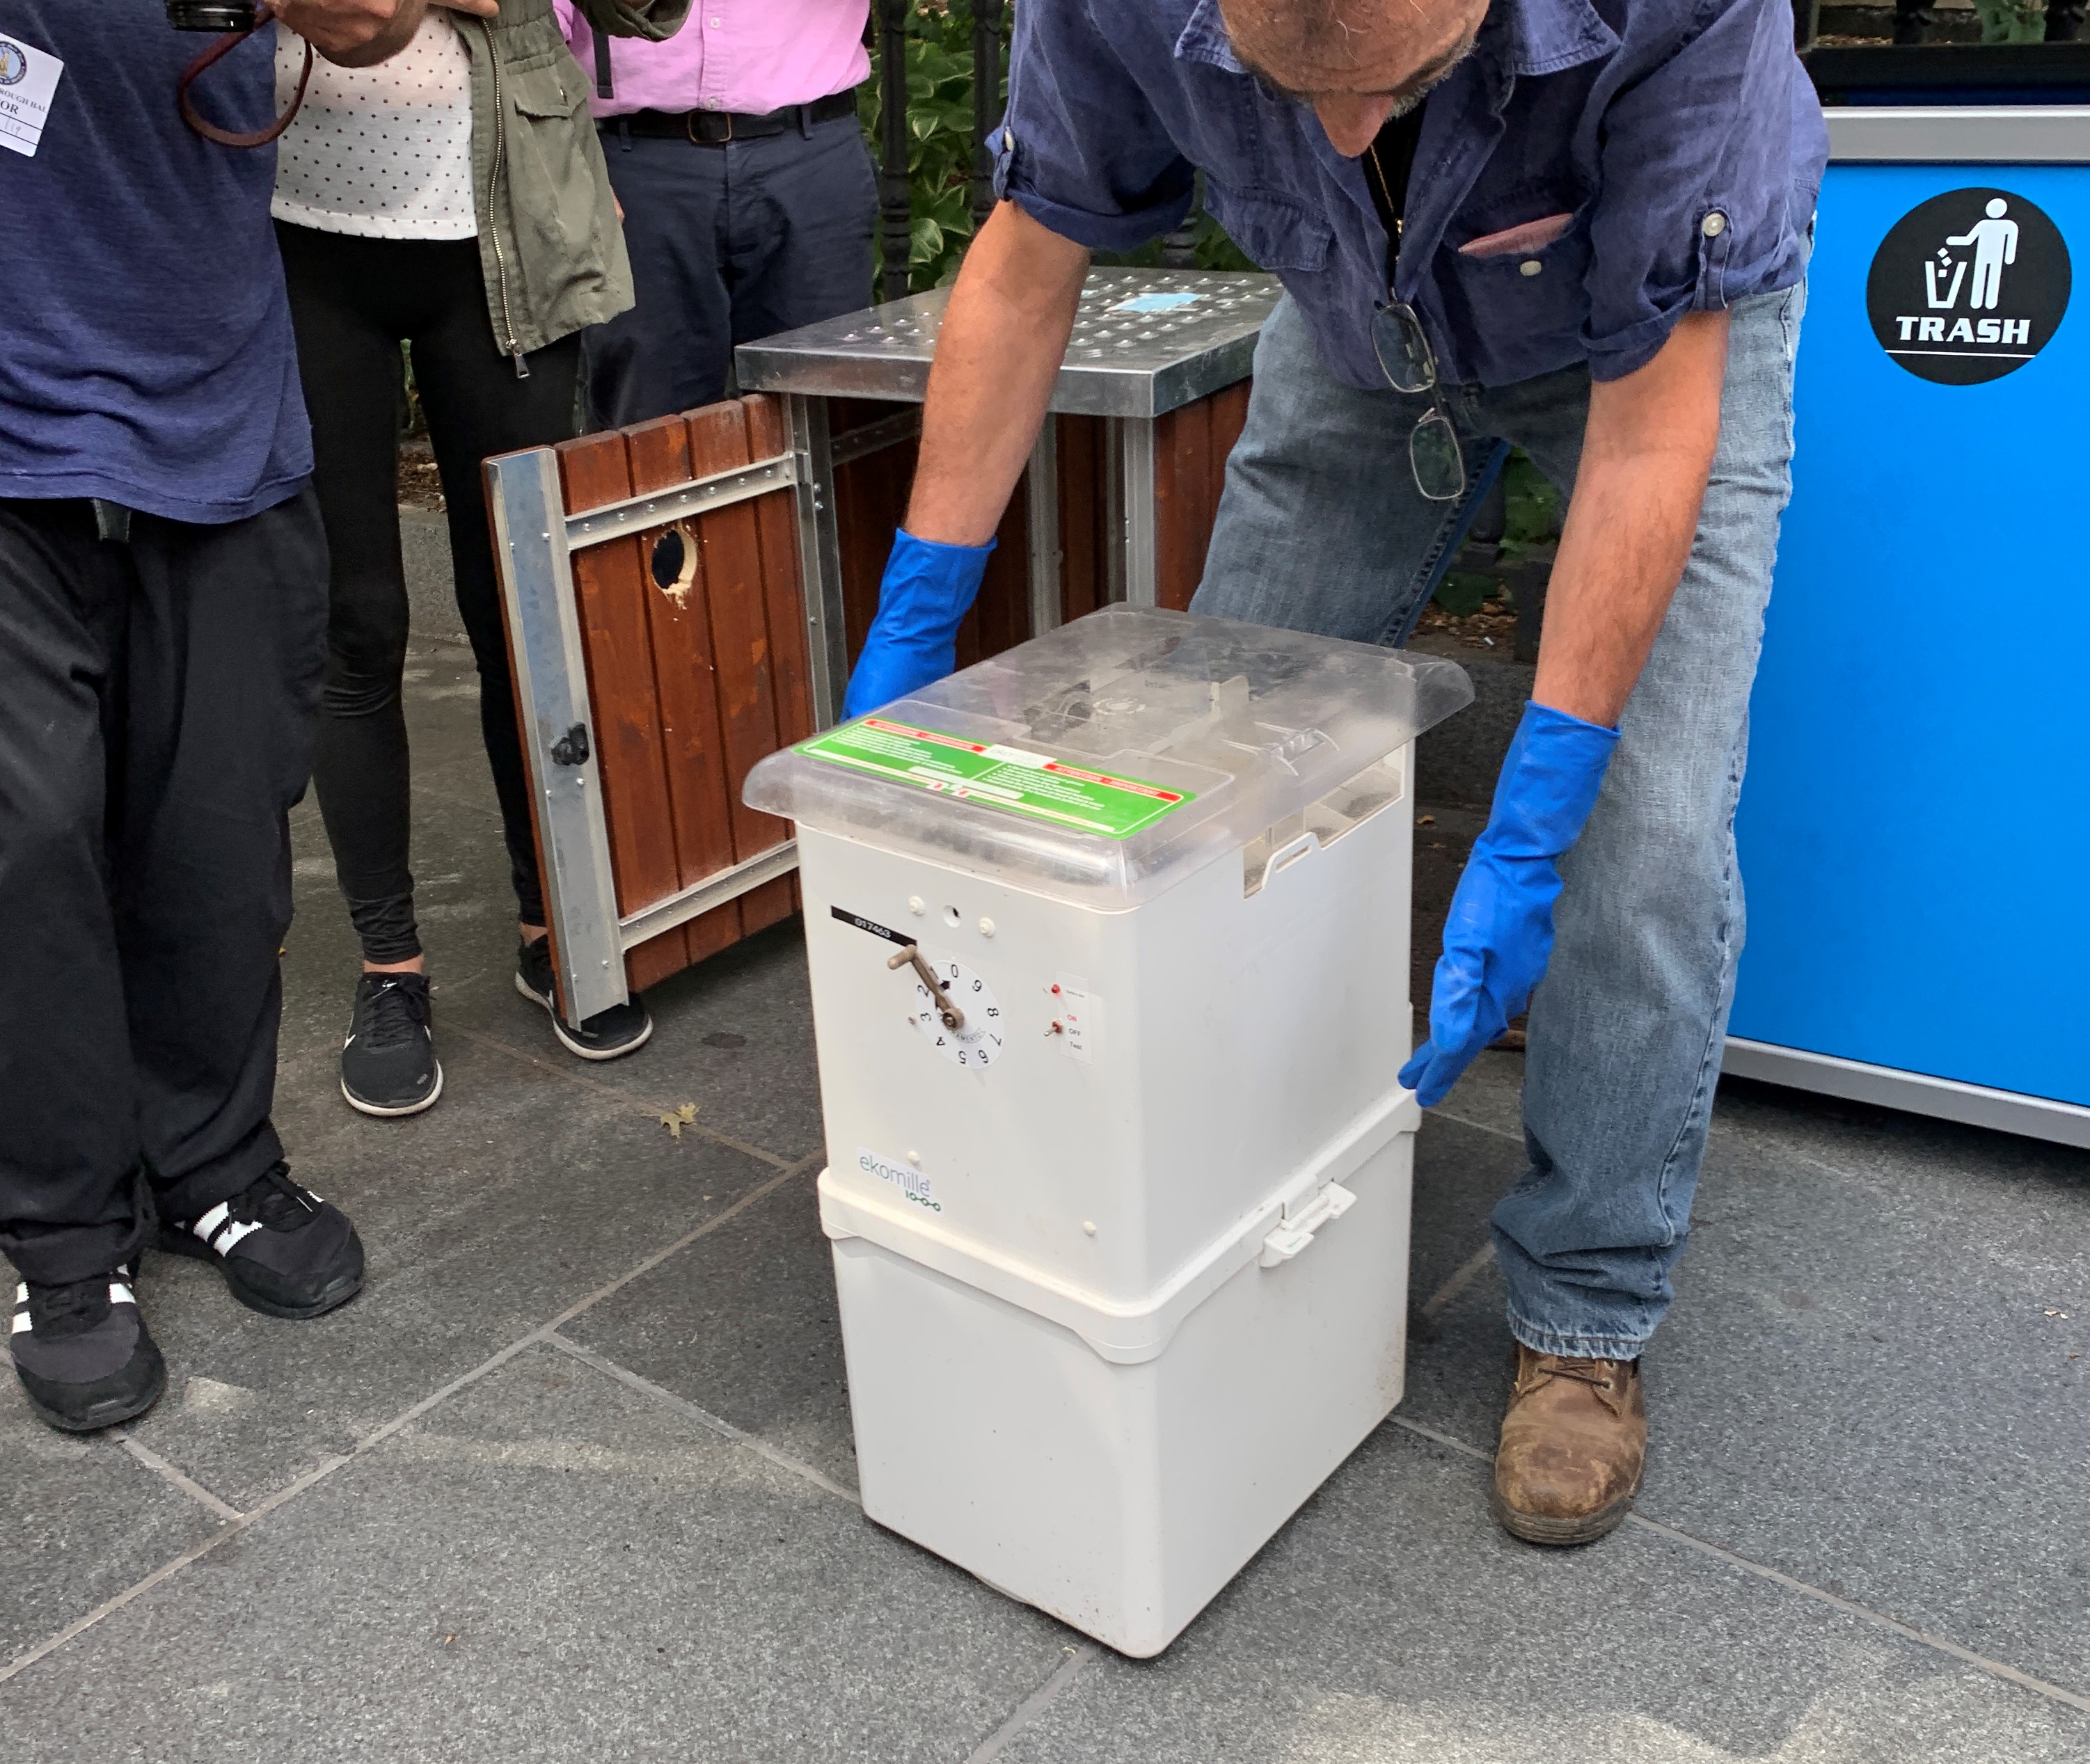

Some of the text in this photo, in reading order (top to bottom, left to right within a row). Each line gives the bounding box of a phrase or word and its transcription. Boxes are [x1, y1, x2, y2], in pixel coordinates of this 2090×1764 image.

[0, 98, 19, 115] OR
[1895, 316, 2032, 344] TRASH
[951, 964, 959, 978] 0
[917, 984, 931, 998] 2
[972, 979, 982, 992] 9
[919, 1012, 932, 1022] 3
[987, 1008, 999, 1017] 8
[1069, 1028, 1081, 1036] OFF
[936, 1036, 946, 1047] 4
[990, 1033, 1002, 1047] 7
[1069, 1041, 1083, 1051] Test
[958, 1050, 967, 1065] 5
[860, 1155, 930, 1198] ekomille
